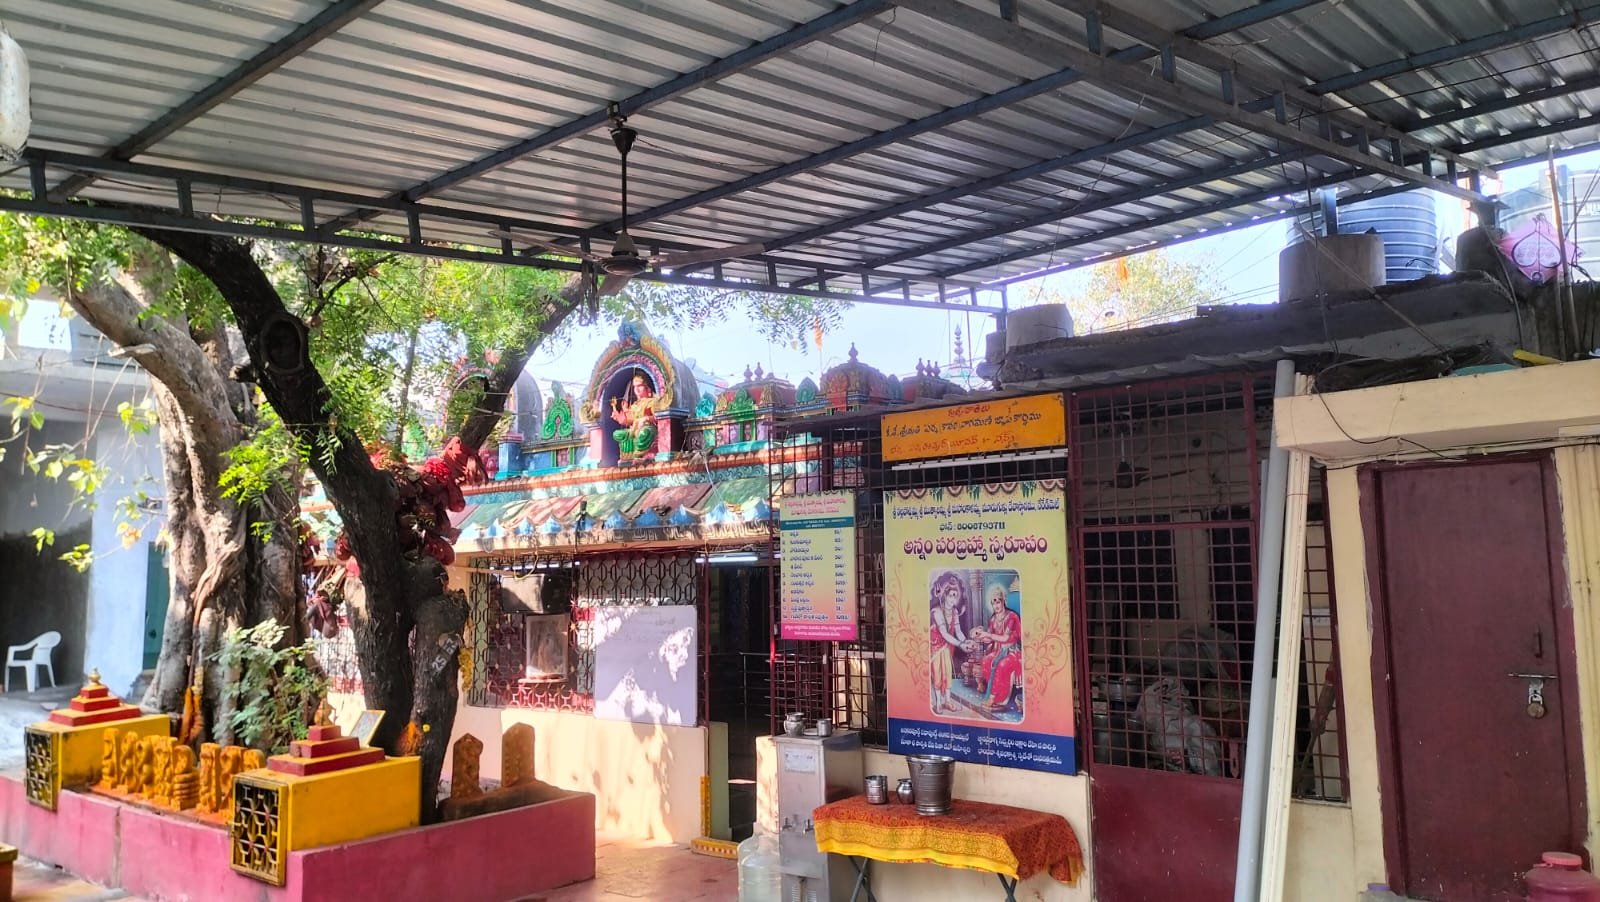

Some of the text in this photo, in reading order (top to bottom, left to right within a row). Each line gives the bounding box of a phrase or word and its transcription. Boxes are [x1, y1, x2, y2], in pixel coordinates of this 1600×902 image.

[903, 536, 933, 560] అన్నం
[989, 535, 1048, 561] స్వరూపం
[431, 655, 447, 671] 25
